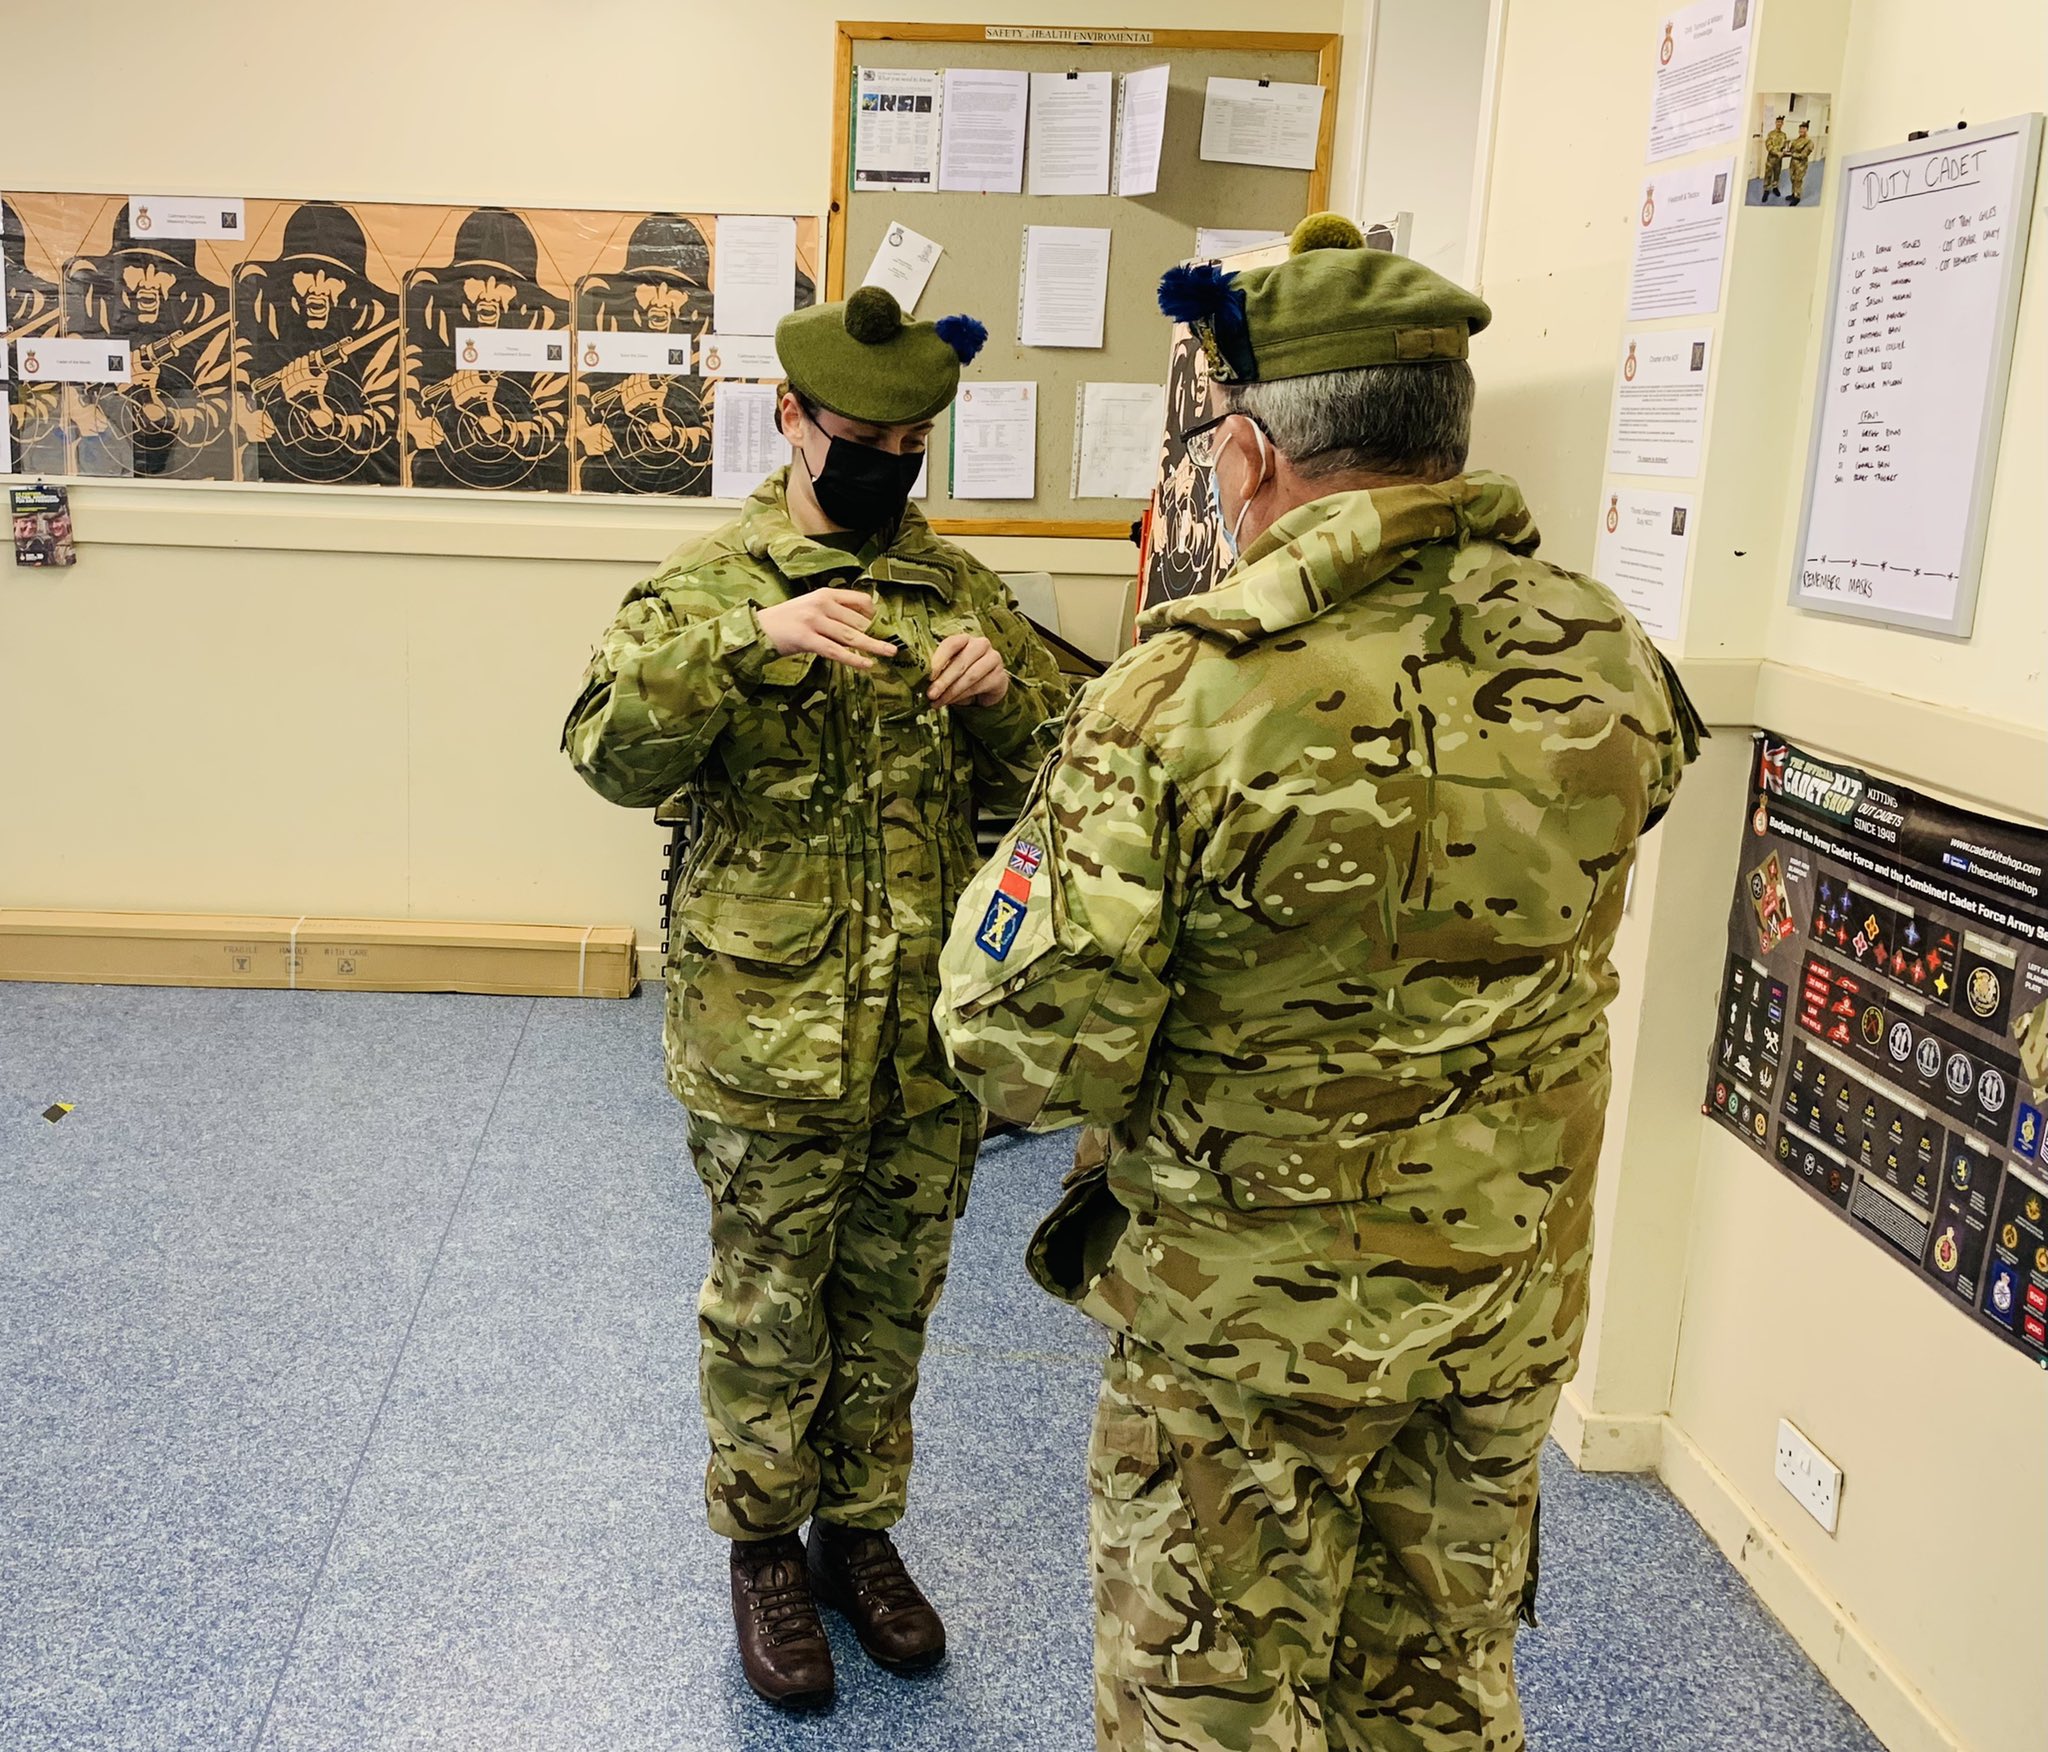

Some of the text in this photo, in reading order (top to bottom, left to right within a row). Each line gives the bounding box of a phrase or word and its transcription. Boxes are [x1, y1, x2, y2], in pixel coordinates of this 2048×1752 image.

[1073, 31, 1152, 43] ENVIROMENTAL
[1862, 149, 1987, 210] DUTY CADET
[1789, 757, 1805, 769] THE
[1783, 767, 1862, 806] CADET KIT
[1867, 788, 1899, 808] KITTING
[1822, 790, 1855, 816] SHOP
[1858, 802, 1904, 828] OUT CADETS
[1854, 817, 1896, 843] SINCE 1949
[1950, 838, 2042, 877] www.cadetkitshop.com
[1769, 816, 1795, 835] Badges
[1795, 827, 1803, 838] of
[1802, 830, 1813, 845] the
[1814, 835, 1831, 853] Army
[1831, 843, 1852, 861] Cadet
[1853, 852, 1874, 870] Force
[1874, 863, 1889, 877] and
[1890, 869, 1904, 884] the
[1904, 874, 1948, 901] Combined
[1949, 892, 1977, 913] Cadet
[1978, 904, 2006, 924] Force
[2007, 914, 2036, 938] Army
[1967, 861, 2038, 897] /thecadetkitshop
